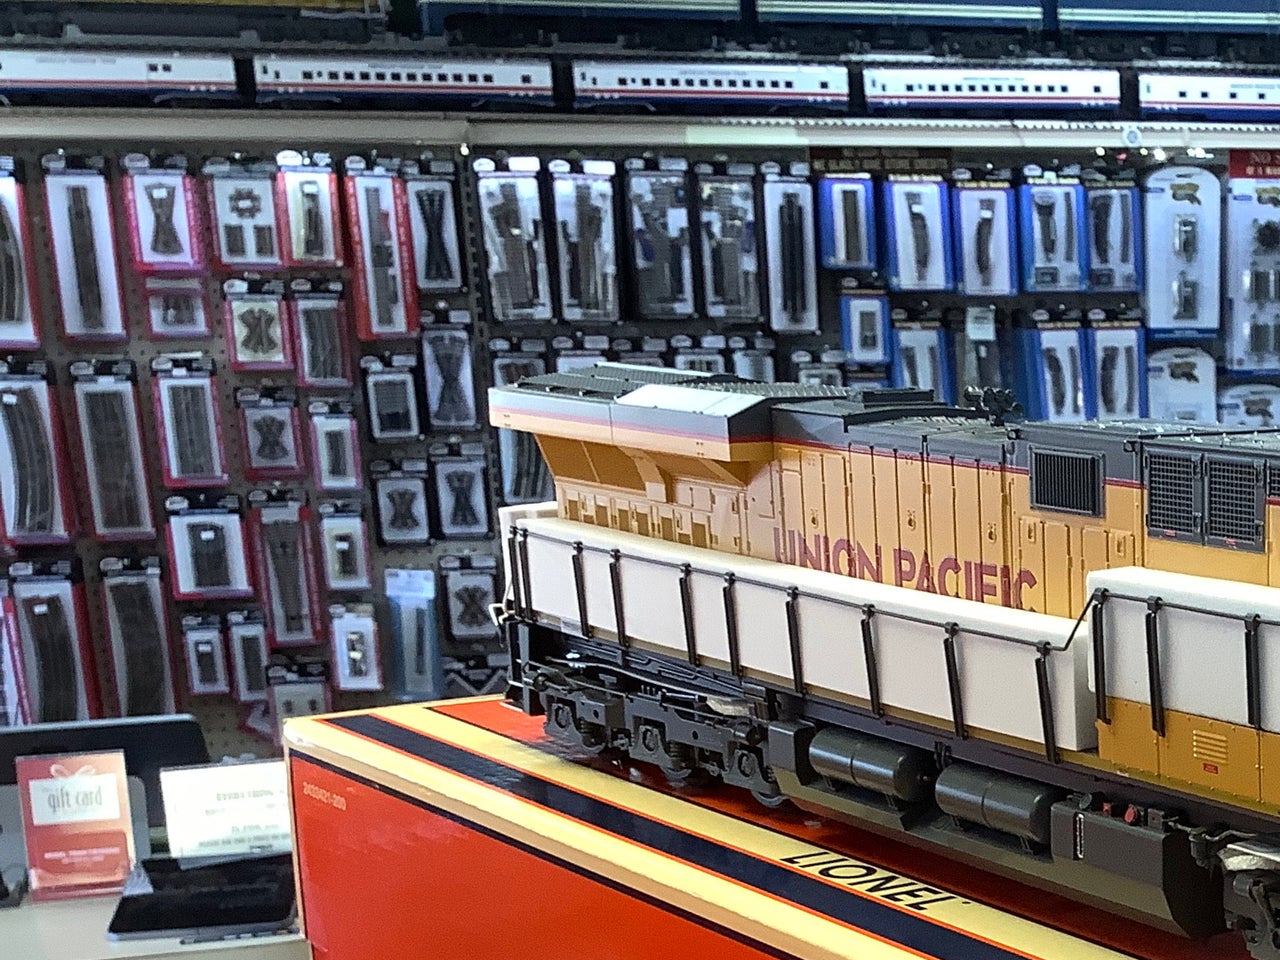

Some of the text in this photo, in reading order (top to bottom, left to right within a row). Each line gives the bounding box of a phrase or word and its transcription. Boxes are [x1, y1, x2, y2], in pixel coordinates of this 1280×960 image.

[773, 527, 1037, 612] UNION PACIFIC
[780, 852, 957, 911] LIONEL
